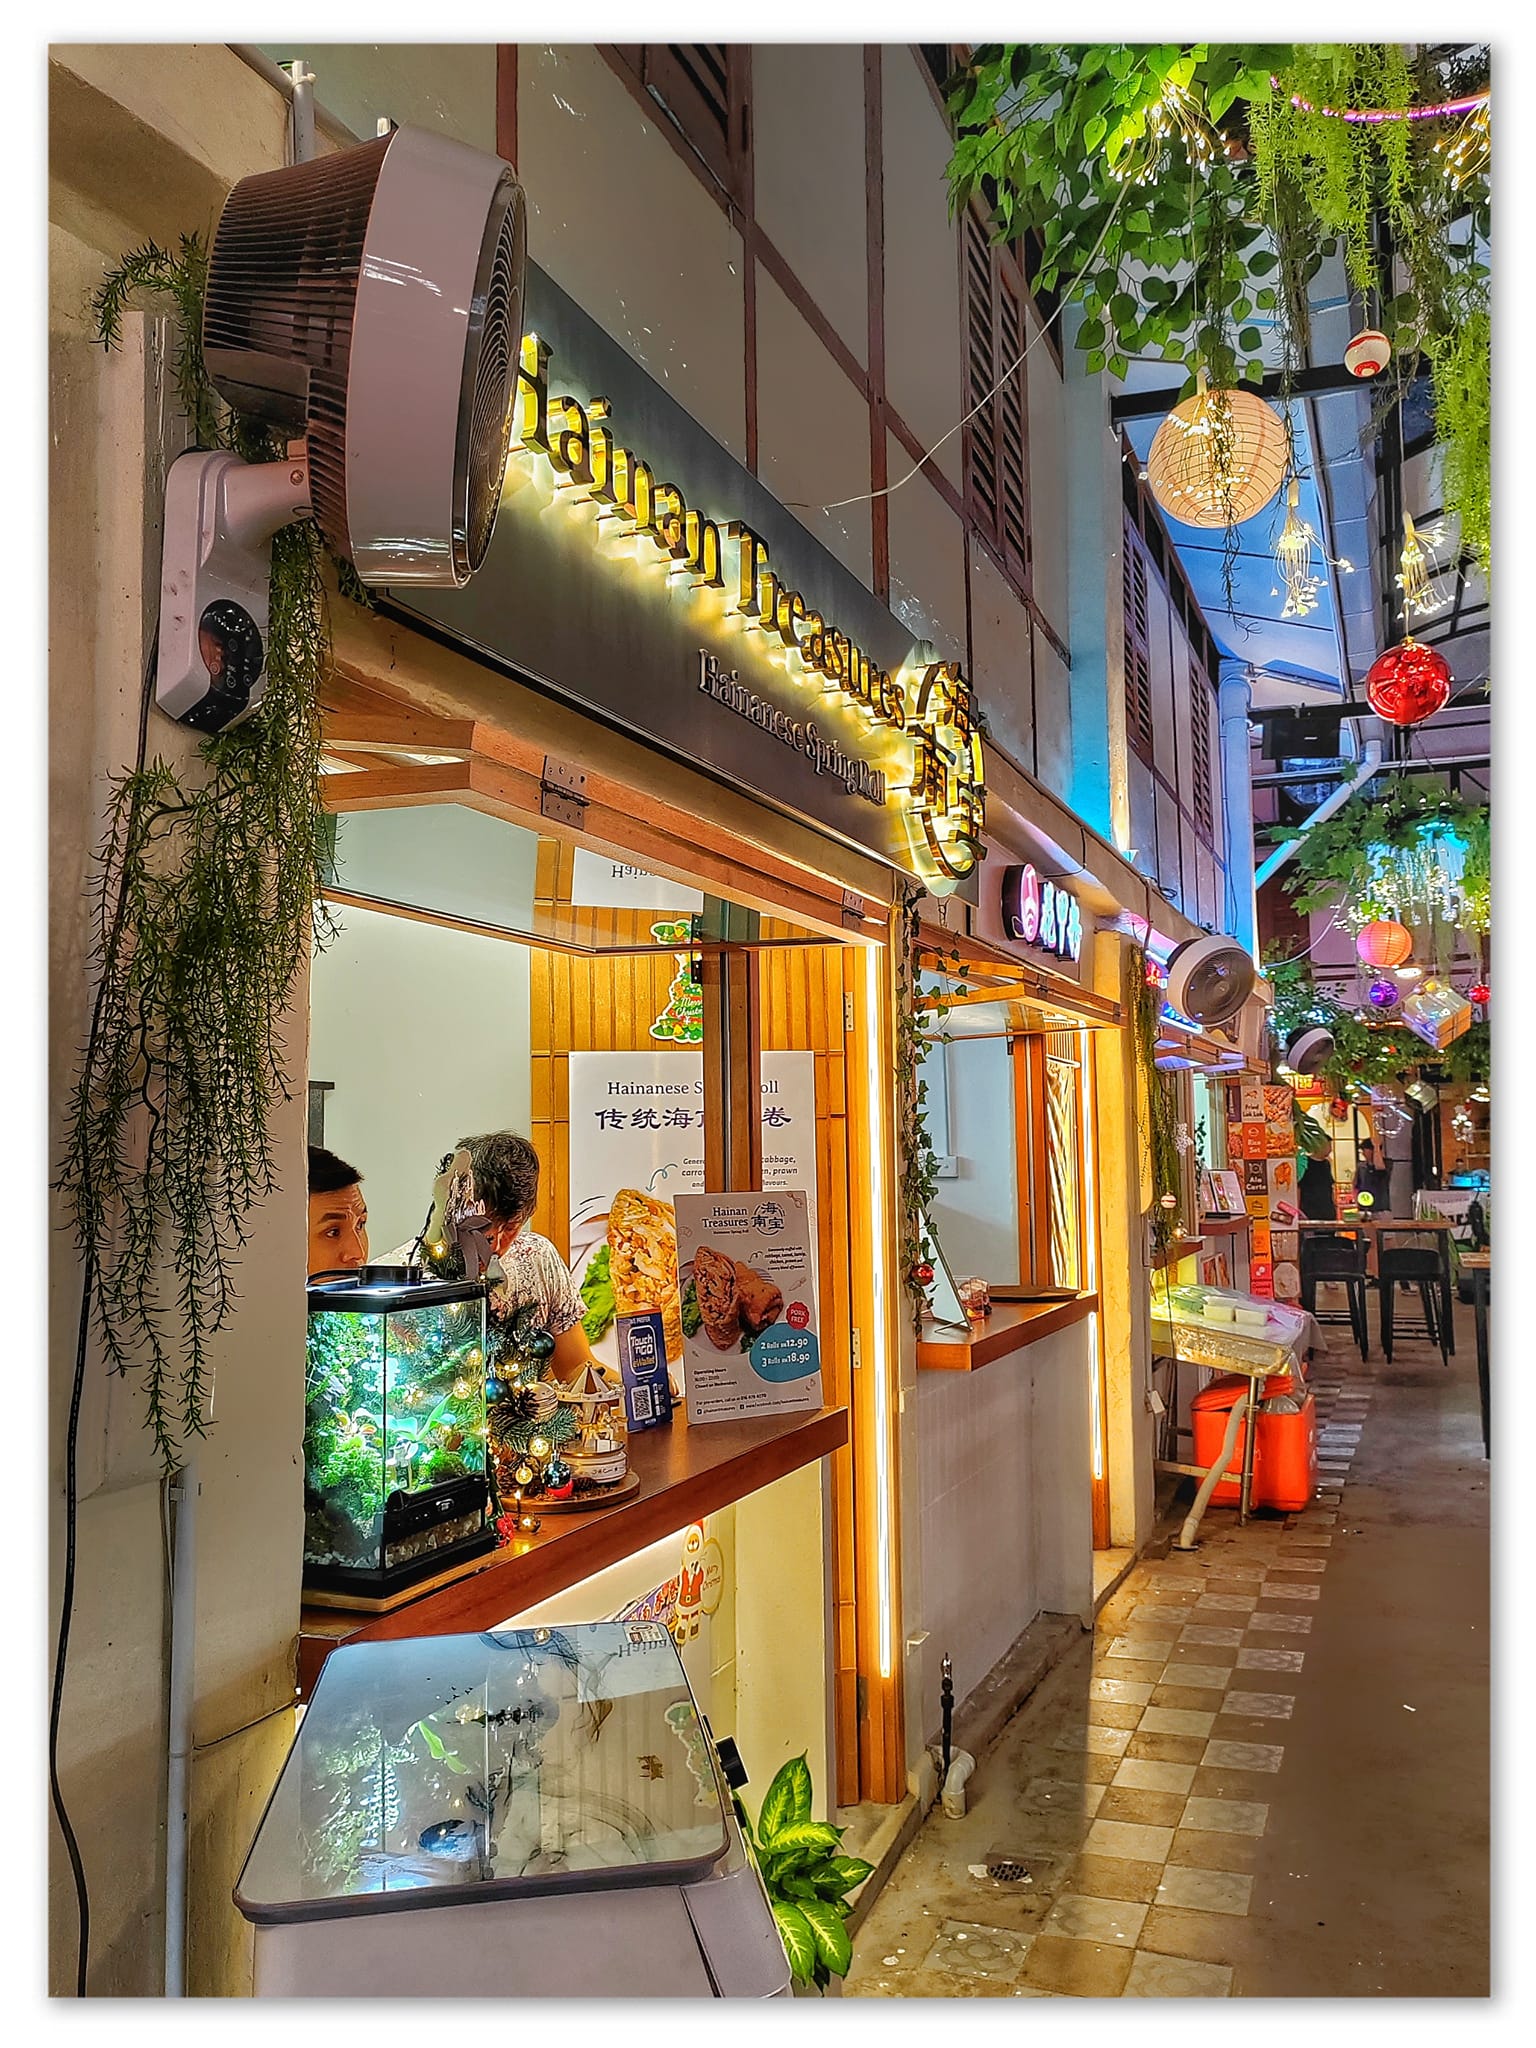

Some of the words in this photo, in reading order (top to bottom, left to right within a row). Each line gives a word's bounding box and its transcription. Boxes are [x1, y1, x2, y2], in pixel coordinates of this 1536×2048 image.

[728, 520, 905, 730] Treasures
[699, 649, 804, 751] Hainanese
[806, 722, 858, 795] Spring
[857, 758, 886, 806] Roll
[608, 1081, 689, 1095] Hainanese
[761, 1080, 779, 1094] oll
[773, 1168, 798, 1176] prawn
[712, 1207, 748, 1216] Hainan
[702, 1218, 748, 1228] Treasures
[790, 1309, 807, 1317] PORK
[631, 1334, 653, 1347] Touch
[761, 1357, 767, 1367] 3
